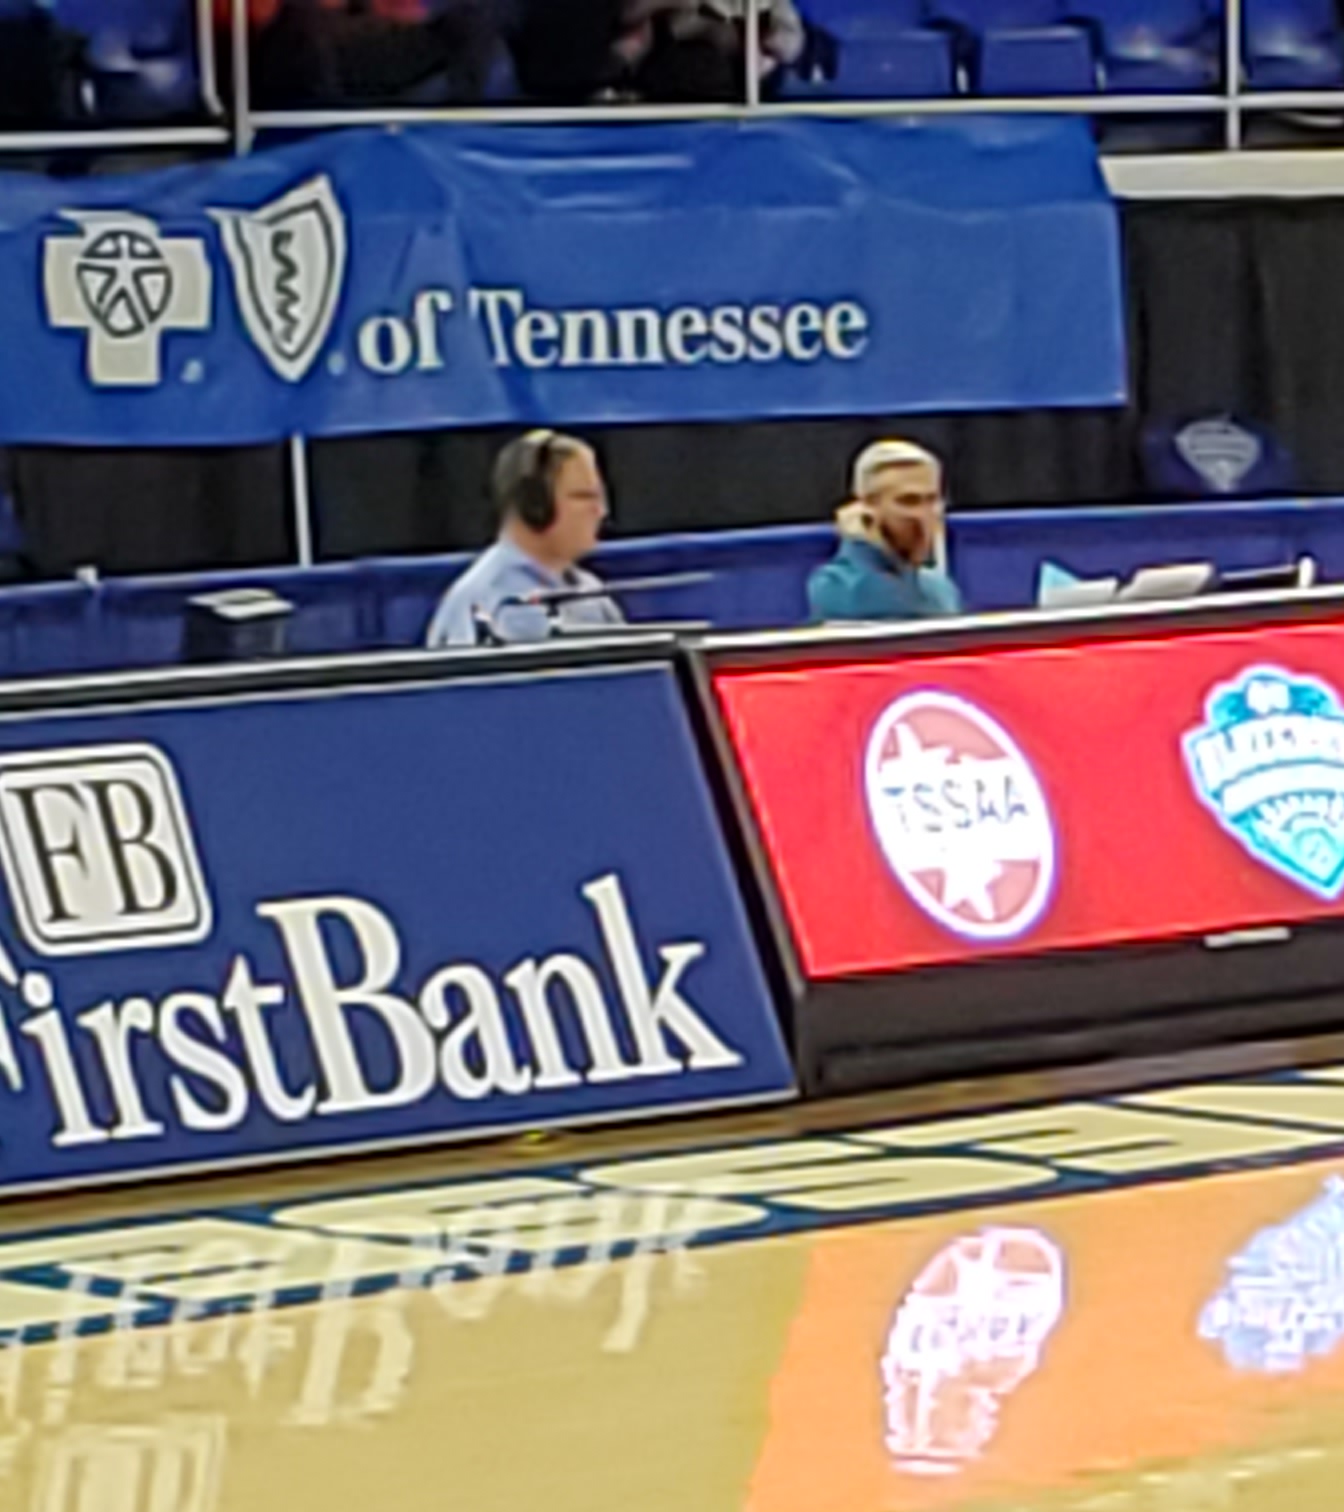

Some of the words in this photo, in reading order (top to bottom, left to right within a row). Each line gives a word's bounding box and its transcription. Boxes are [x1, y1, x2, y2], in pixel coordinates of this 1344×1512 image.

[359, 289, 449, 375] of
[470, 286, 870, 370] Tennessee
[4, 777, 178, 925] FB
[0, 872, 744, 1147] irstBank
